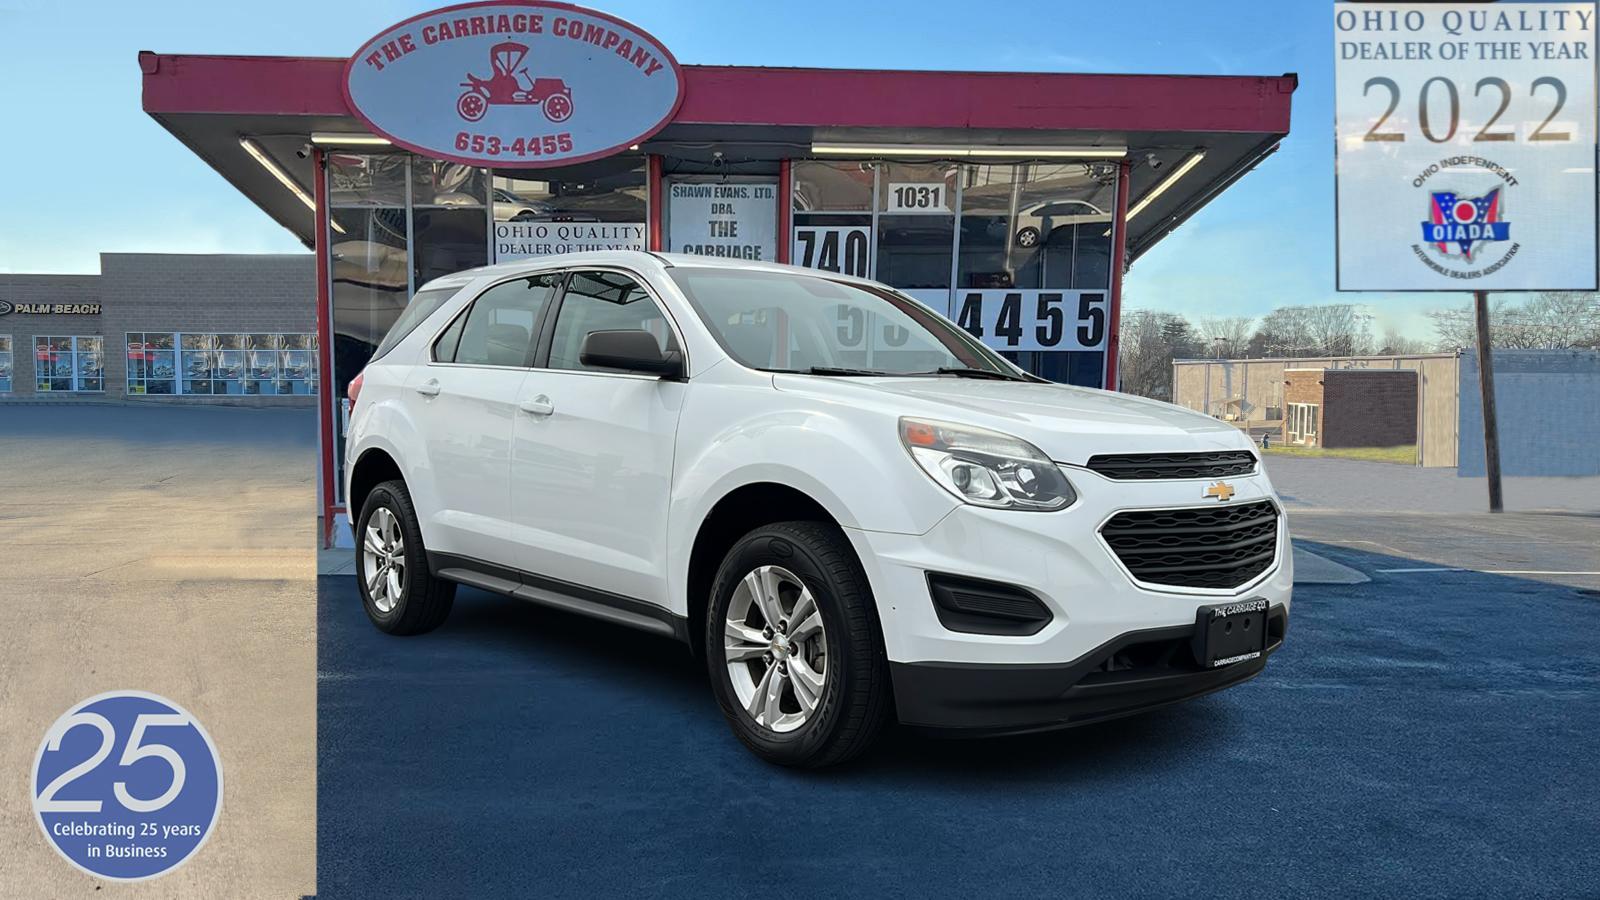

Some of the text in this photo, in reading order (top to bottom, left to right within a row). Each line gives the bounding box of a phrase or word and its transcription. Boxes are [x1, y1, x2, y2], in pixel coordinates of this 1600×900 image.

[1336, 10, 1592, 35] OHIO QUALITY
[365, 14, 664, 77] THE CARRIAGE COMPANY
[1341, 42, 1589, 60] DEALER OF THE YEAR
[1363, 76, 1571, 143] 2022
[455, 131, 573, 156] 653-4455
[1413, 156, 1519, 188] OHIO INDEPENDENT
[673, 186, 712, 198] SHAWN
[754, 188, 774, 199] LTD.
[894, 186, 940, 208] 1031
[711, 203, 736, 215] DBA.
[497, 226, 644, 240] OHIO QUALITY
[709, 221, 737, 237] THE
[1433, 225, 1495, 240] OIADA
[499, 244, 641, 255] DEALER OF THE YEAR
[683, 244, 762, 261] CARRIAGE
[797, 230, 868, 278] 740
[1411, 242, 1520, 280] AUTOMOBILE DEALERS ASSOCIATION
[14, 304, 51, 314] PALM
[54, 304, 100, 314] BEACH
[957, 293, 1104, 347] 4455
[1214, 608, 1227, 617] THE
[1227, 602, 1257, 615] CARRIAGE
